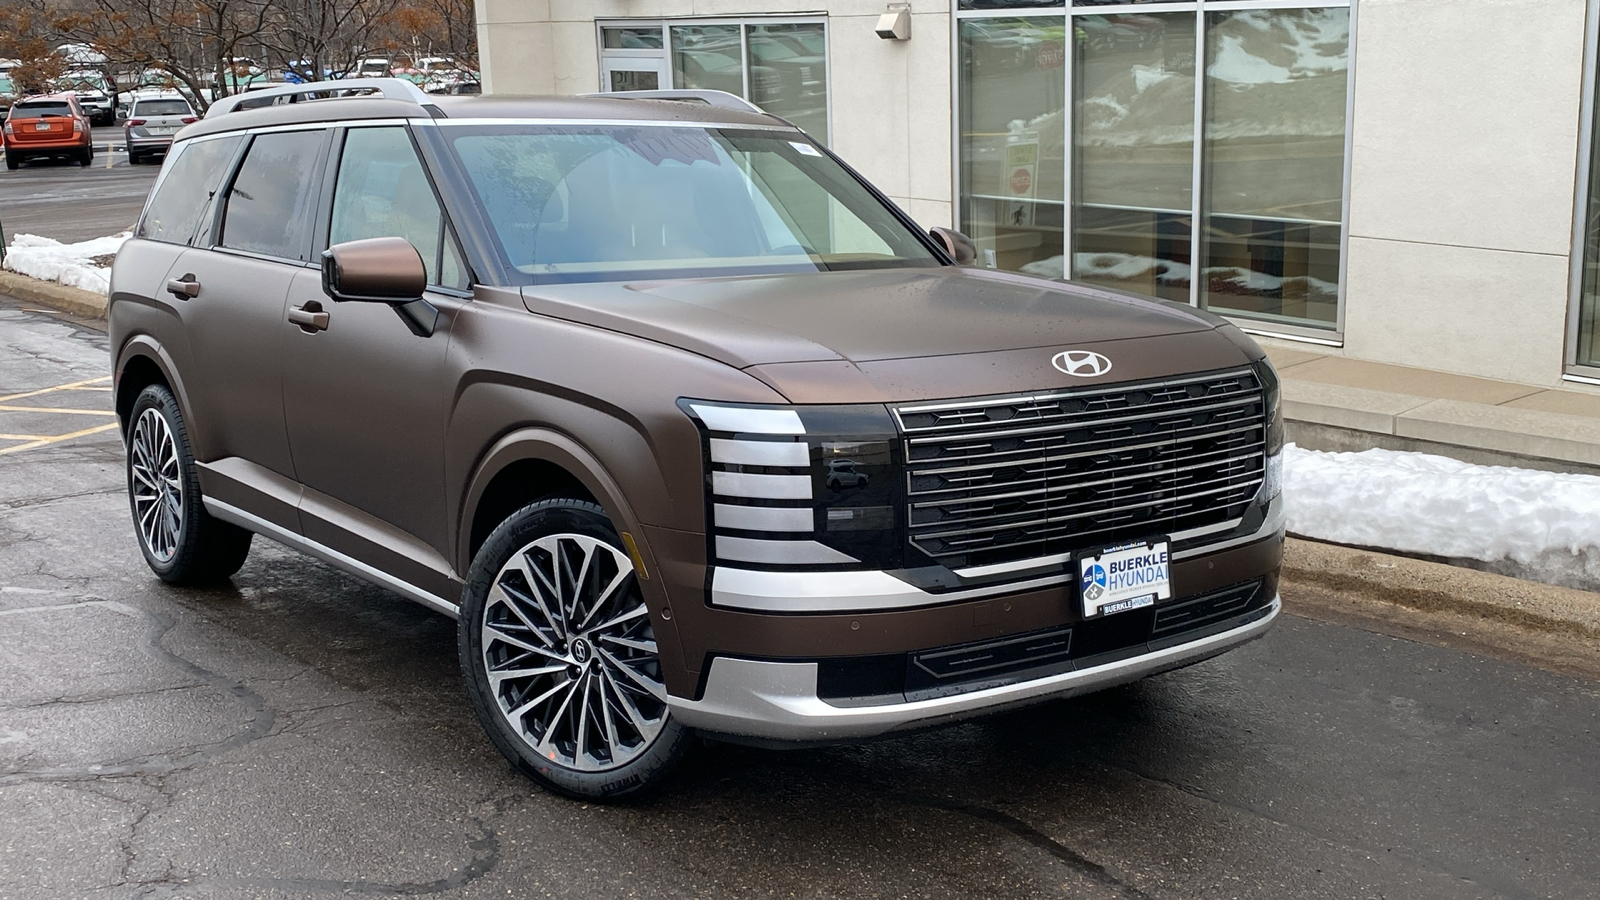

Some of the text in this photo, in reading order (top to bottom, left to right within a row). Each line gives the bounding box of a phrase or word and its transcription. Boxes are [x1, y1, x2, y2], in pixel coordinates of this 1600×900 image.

[1110, 552, 1167, 574] BUERKLE
[1109, 565, 1168, 591] HYUNDAI
[1104, 600, 1132, 614] BUERKLE
